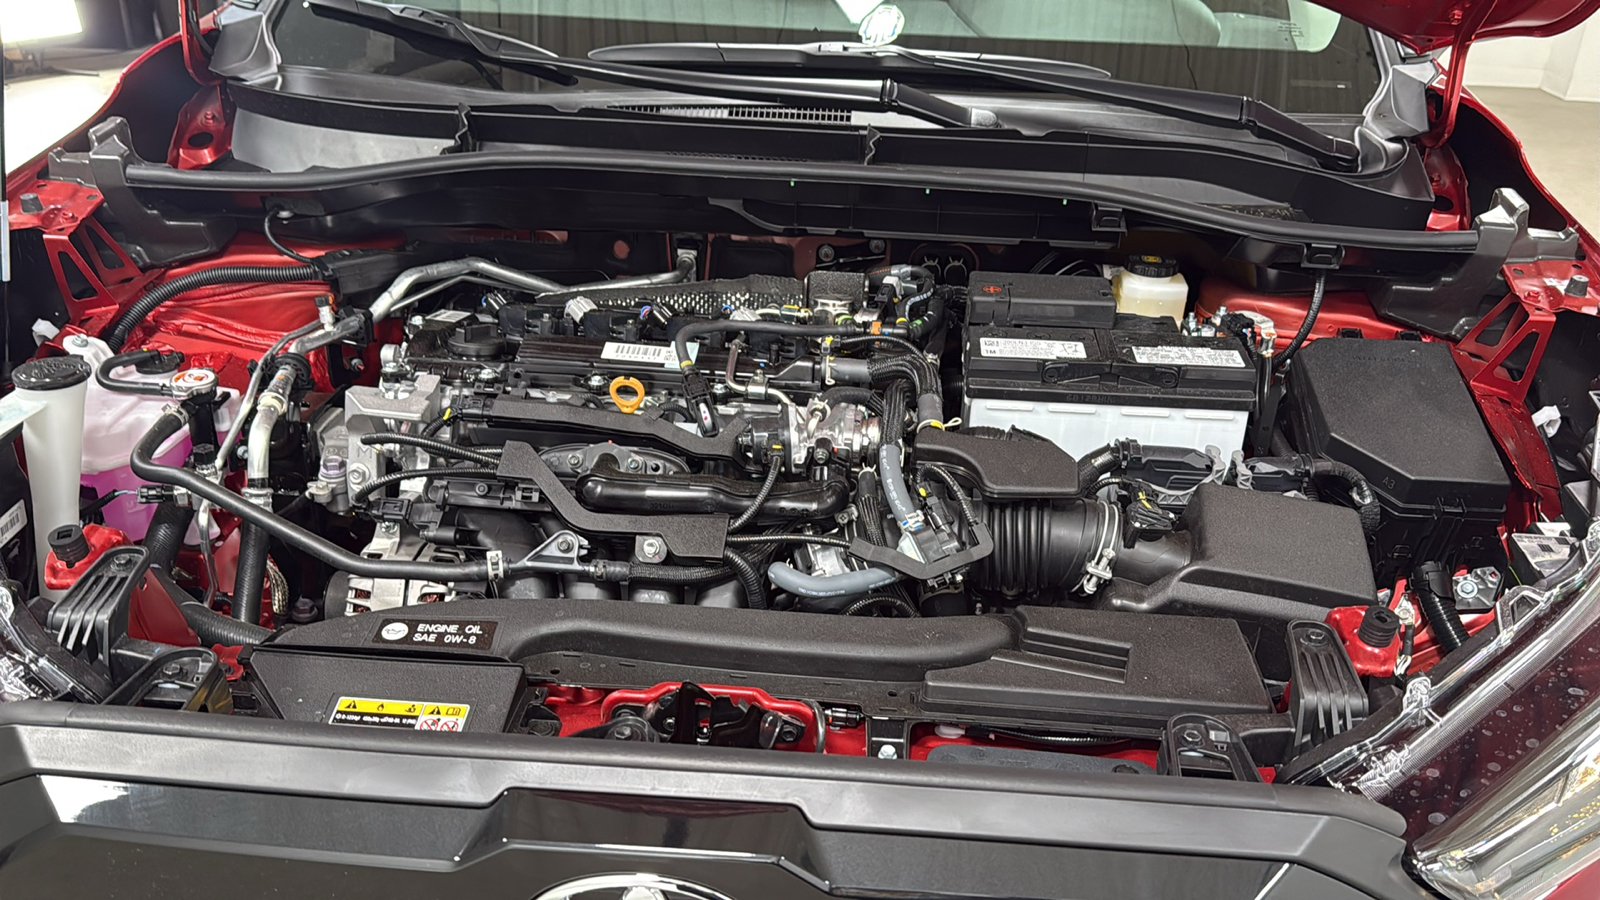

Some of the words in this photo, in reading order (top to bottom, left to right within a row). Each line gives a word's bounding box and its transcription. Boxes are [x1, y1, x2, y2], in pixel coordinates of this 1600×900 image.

[417, 623, 459, 633] ENGINE
[465, 624, 483, 634] OIL
[412, 633, 437, 642] SAE
[443, 634, 477, 645] 0W-8
